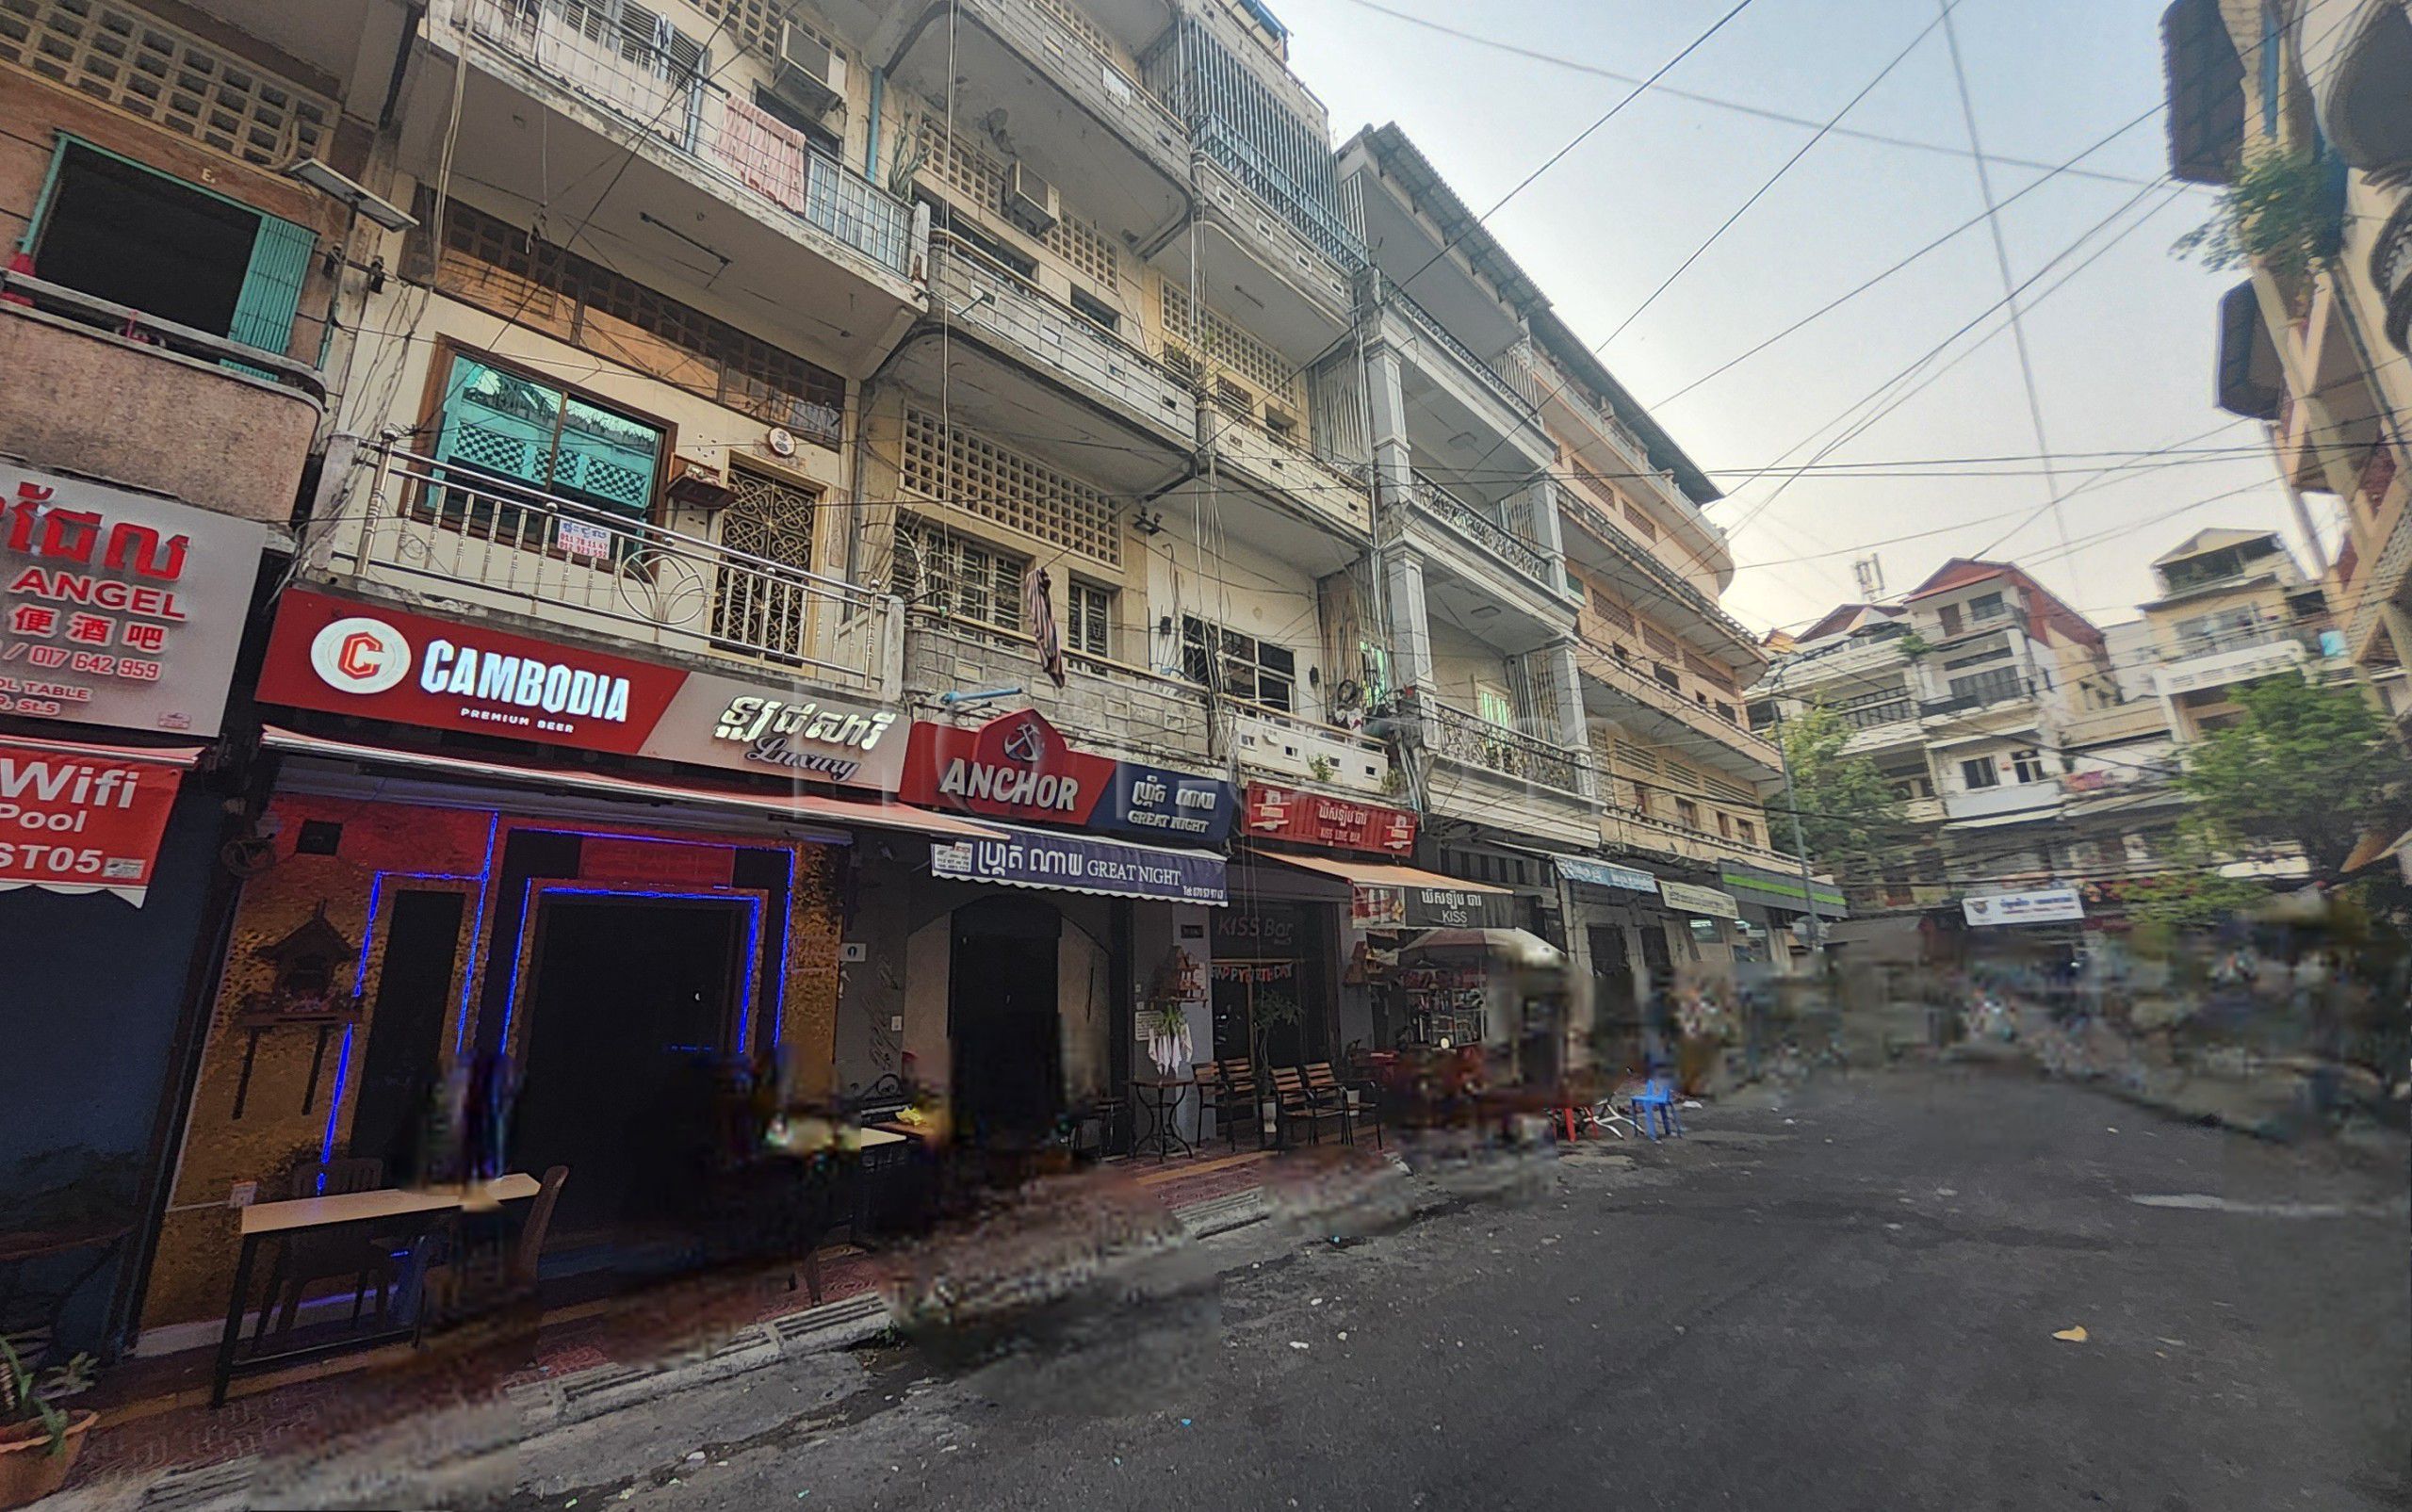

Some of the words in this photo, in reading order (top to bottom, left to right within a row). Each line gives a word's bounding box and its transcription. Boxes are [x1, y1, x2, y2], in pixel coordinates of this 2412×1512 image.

[0, 481, 189, 581] ជែល
[10, 568, 187, 619] ANGEL
[32, 647, 68, 667] 017
[74, 653, 114, 673] 642
[120, 658, 159, 678] 959
[25, 682, 90, 700] TABLE
[420, 639, 630, 723] CAMBODIA
[460, 707, 530, 726] PREMIUM
[537, 720, 574, 733] BEER
[745, 737, 861, 782] Luxury
[0, 757, 140, 808] Wifi
[938, 757, 1079, 811] ANCHOR
[1128, 810, 1171, 829] GREAT
[1169, 816, 1210, 833] NIGHT
[1087, 858, 1137, 882] GREAT
[1138, 865, 1182, 886] NIGHT
[1219, 916, 1261, 936] KISS
[1264, 918, 1295, 937] Bar
[1442, 910, 1468, 924] KISS
